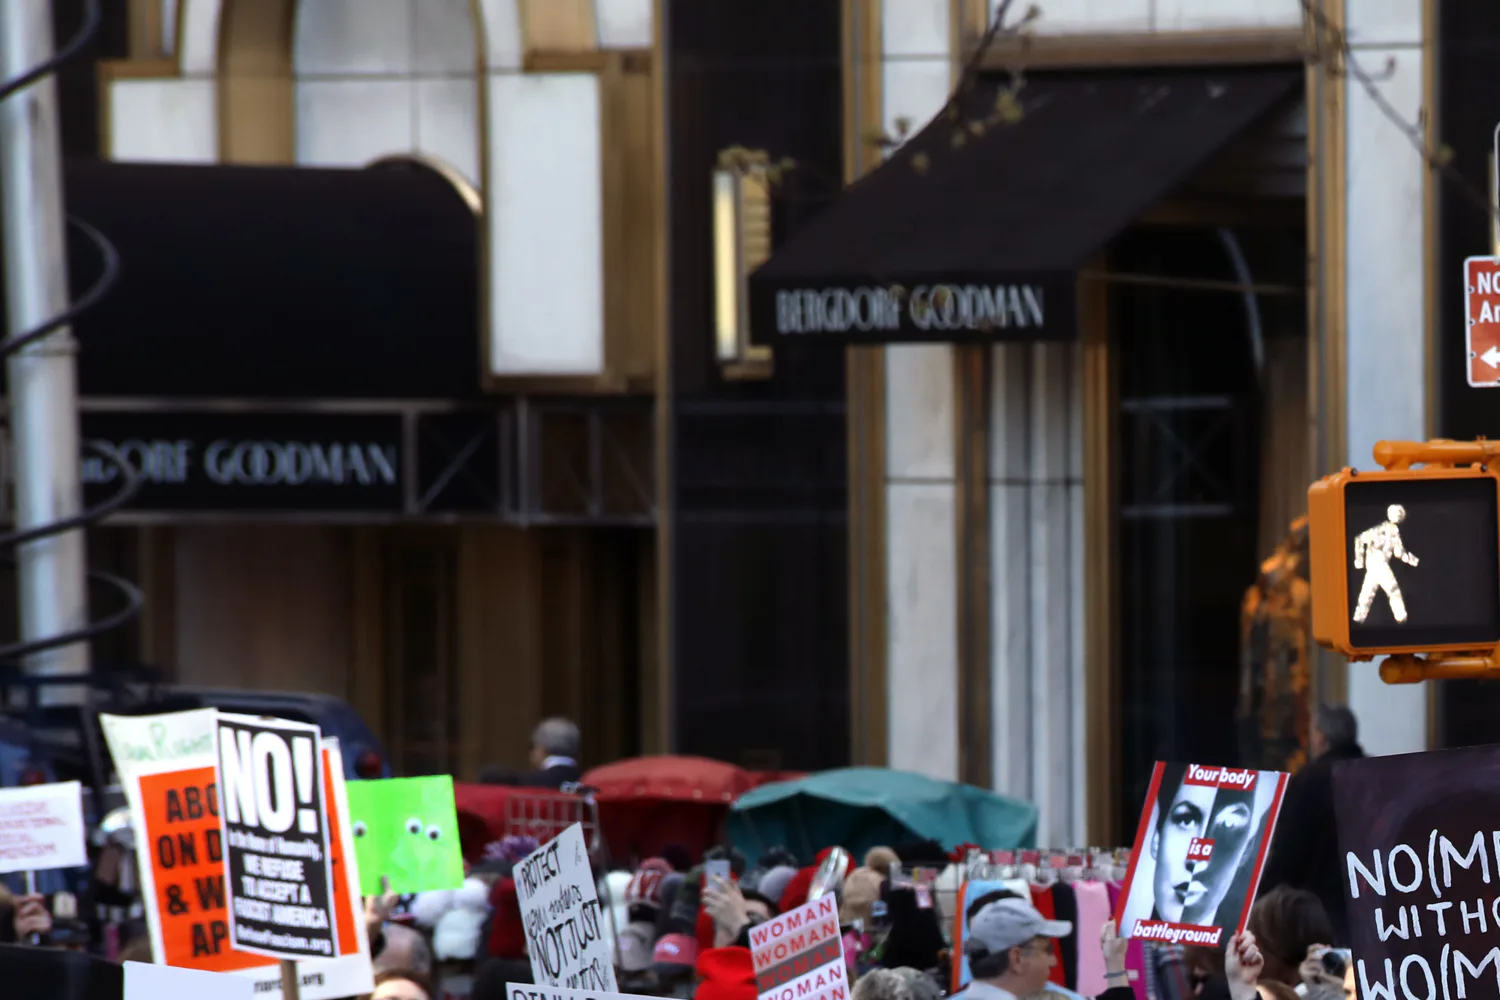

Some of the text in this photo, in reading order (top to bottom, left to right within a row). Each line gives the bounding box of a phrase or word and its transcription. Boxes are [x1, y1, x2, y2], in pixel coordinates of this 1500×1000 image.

[776, 283, 1044, 334] BERGDORF GOODMAN
[204, 439, 398, 485] GOODMAN
[217, 725, 318, 834] NO!
[1188, 764, 1255, 788] Your body
[157, 831, 197, 869] ON
[520, 842, 562, 900] PROTECT
[1189, 840, 1214, 856] is a
[272, 903, 328, 929] AMERICA
[751, 898, 833, 946] WOMAN
[1133, 919, 1223, 943] battleground
[535, 923, 569, 982] NOT
[565, 899, 602, 960] JUST
[755, 919, 836, 969] WOMAN
[758, 941, 841, 990] WOMAN
